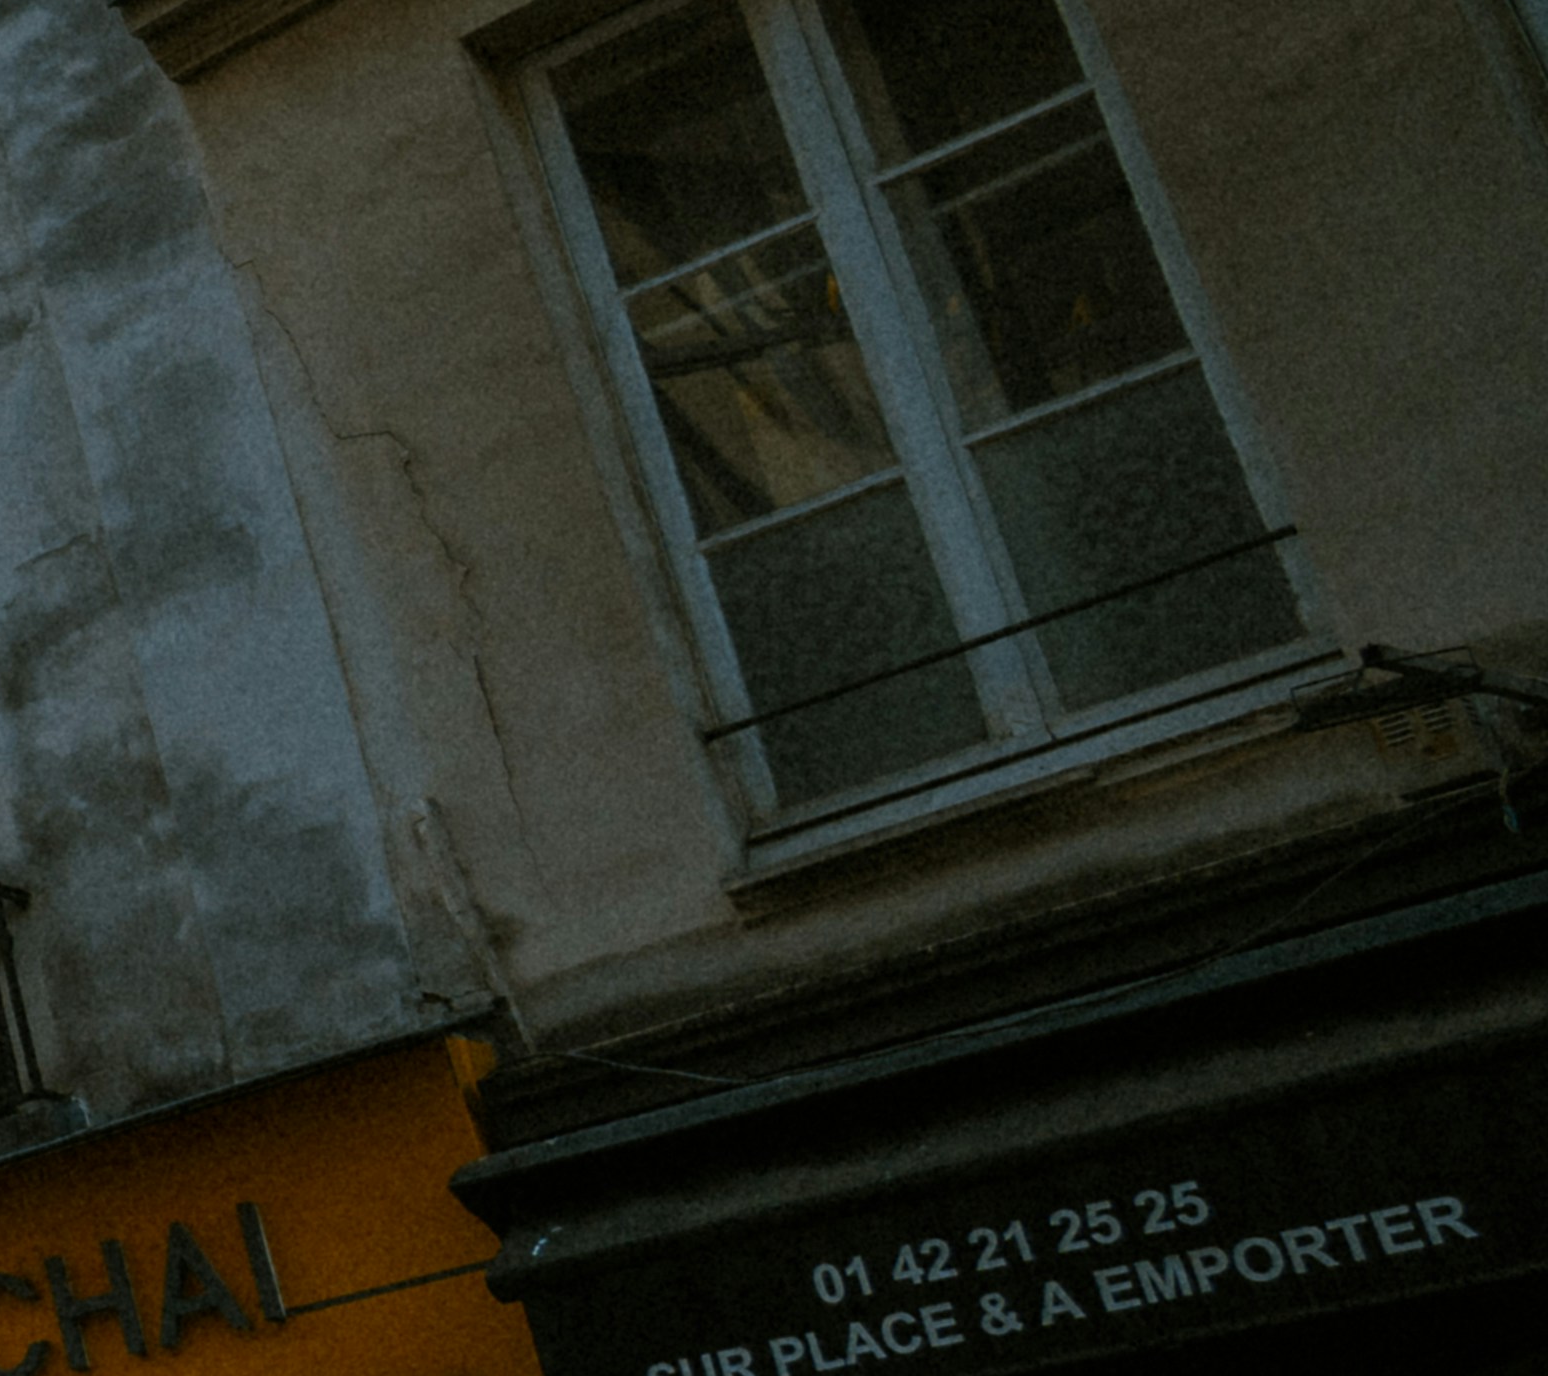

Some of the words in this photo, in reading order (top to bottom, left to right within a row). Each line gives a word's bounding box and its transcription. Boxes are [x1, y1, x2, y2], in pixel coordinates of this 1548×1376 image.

[811, 1255, 875, 1306] 01
[890, 1237, 958, 1289] 42
[967, 1220, 1038, 1272] 21
[1046, 1198, 1125, 1256] 25
[1132, 1179, 1213, 1236] 25
[976, 1290, 1026, 1337] &
[1039, 1278, 1088, 1328] A
[1093, 1194, 1481, 1313] EMPORTER
